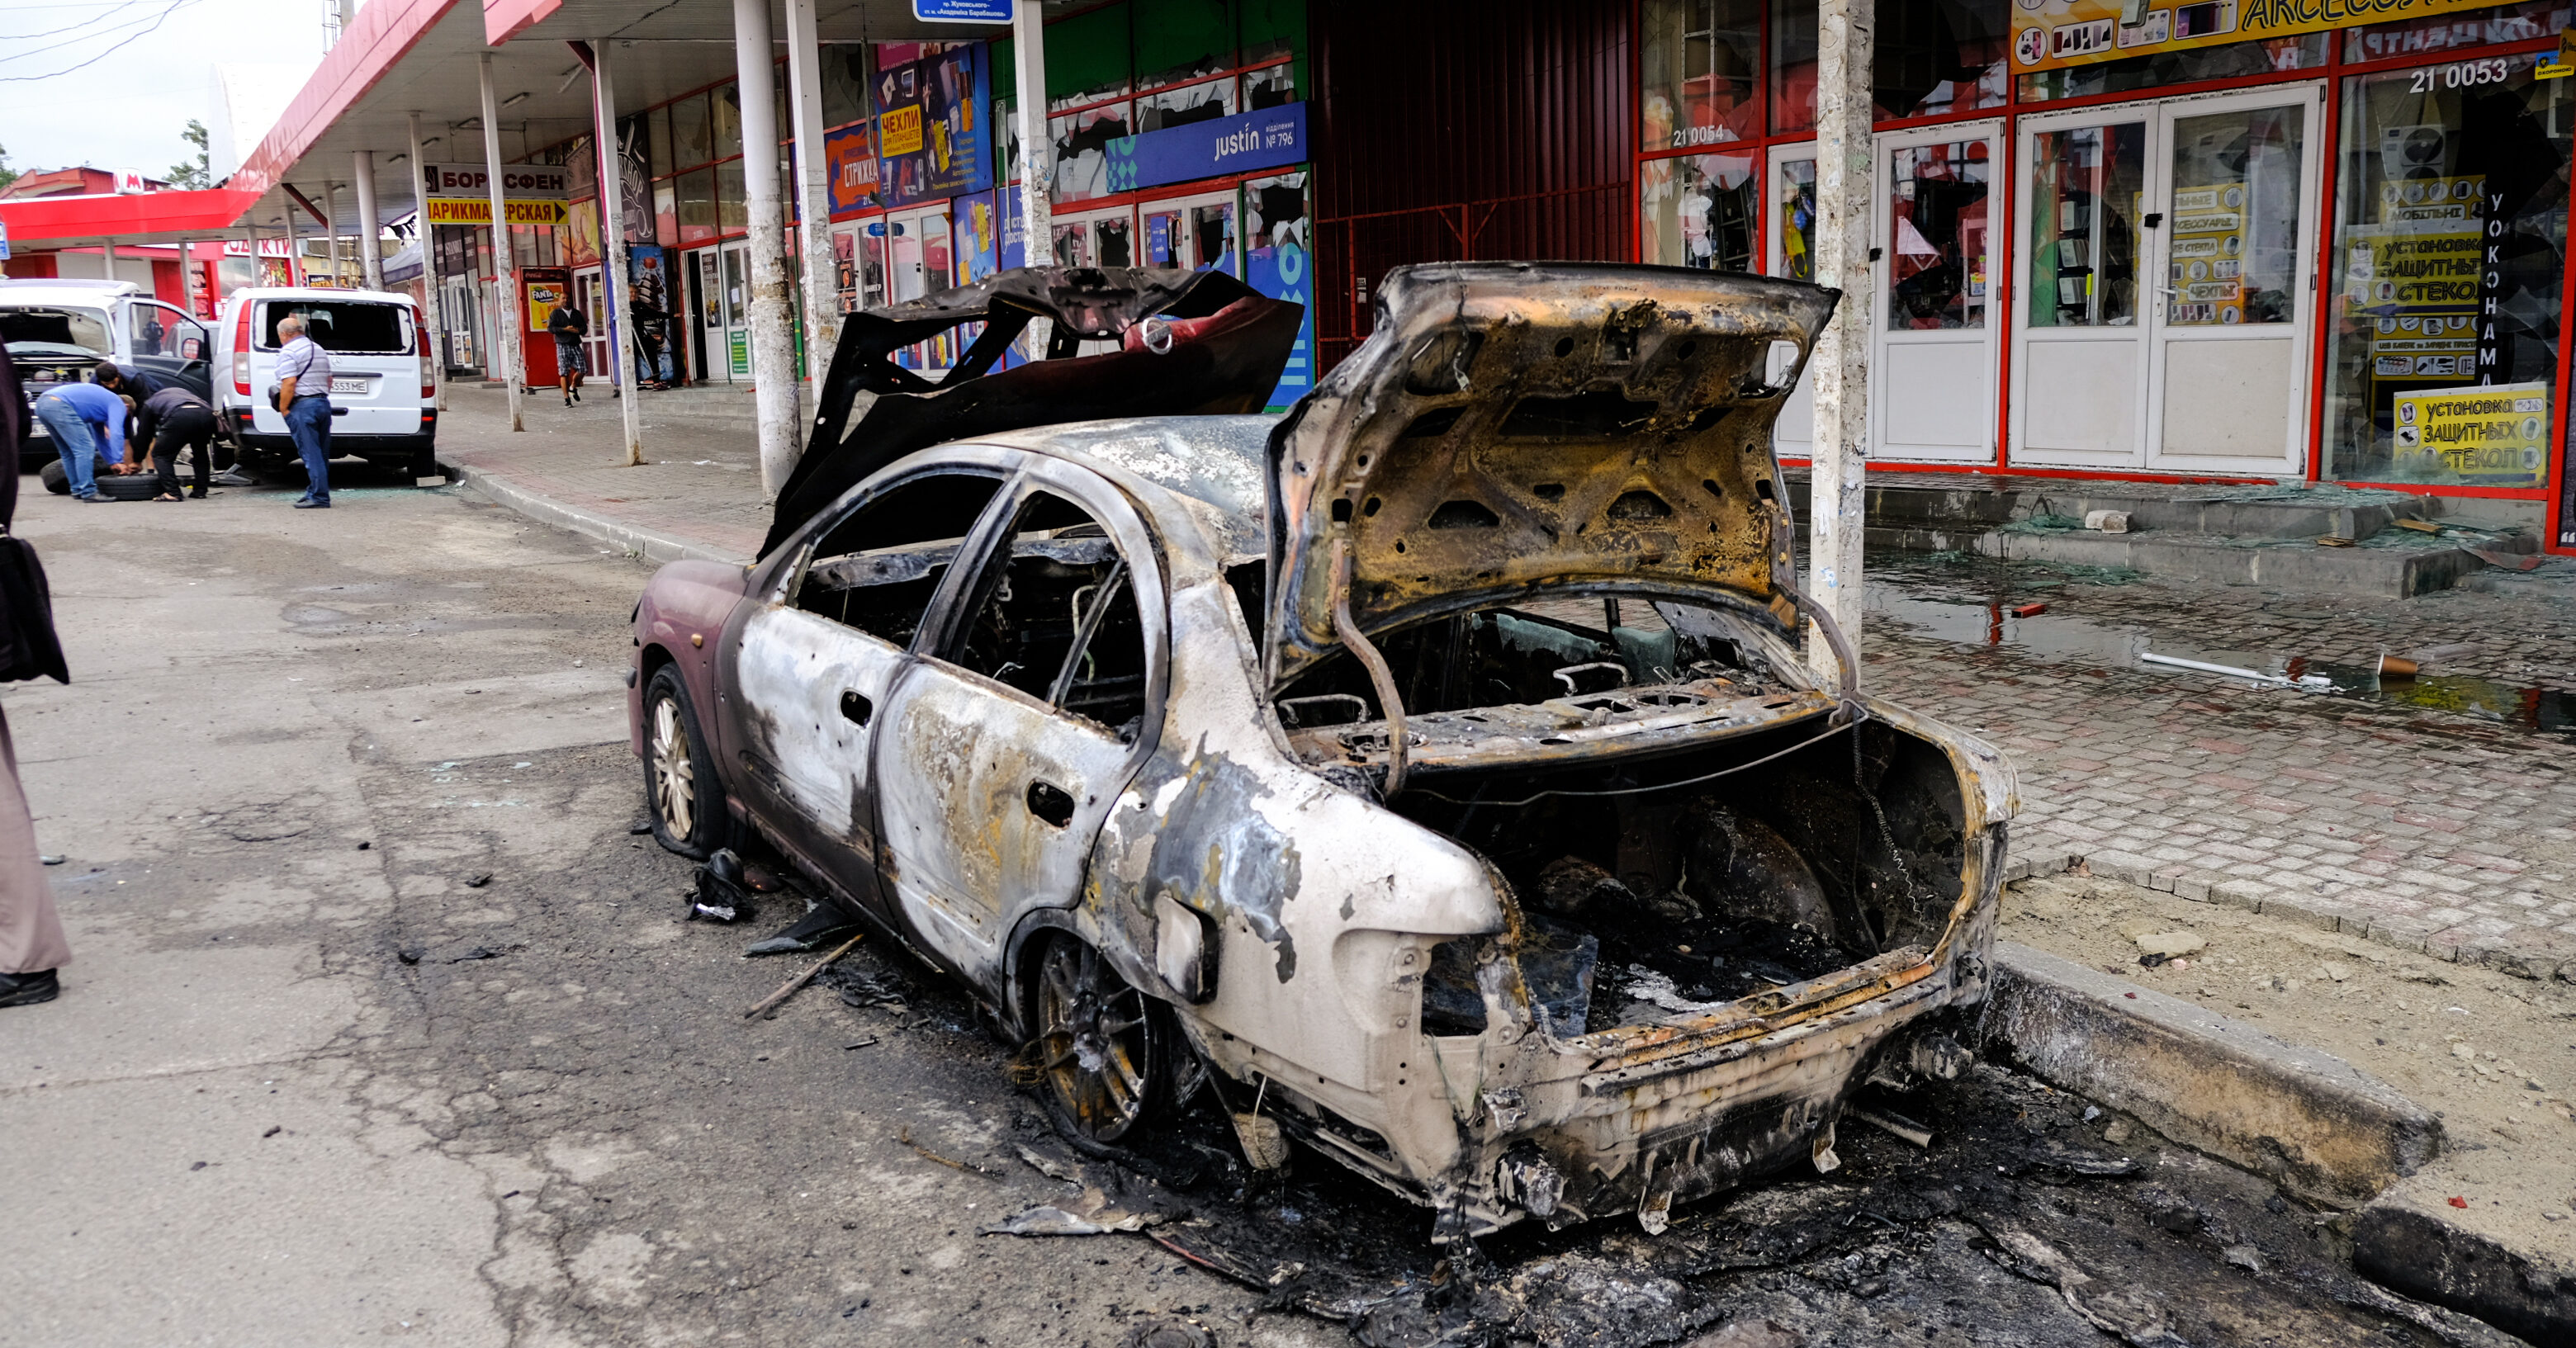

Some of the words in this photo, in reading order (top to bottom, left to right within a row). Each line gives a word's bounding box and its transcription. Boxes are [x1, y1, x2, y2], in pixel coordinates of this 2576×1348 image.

[2409, 68, 2435, 93] 21
[2446, 59, 2507, 88] 0053
[2537, 67, 2572, 76] ОХОРОНОЮ
[882, 109, 919, 135] ЧЕХЛИ
[1266, 121, 1295, 133] відділення
[1278, 132, 1293, 147] 796
[1673, 129, 1686, 146] 21
[1691, 124, 1724, 144] 0054
[443, 172, 564, 190] БОРСФЕН
[618, 154, 644, 199] RSHOP
[844, 158, 879, 188] СТРИЖКА
[2380, 258, 2480, 279] ЗАЩИТНЫ
[2190, 286, 2236, 299] ЧЕХЛЫ
[2397, 281, 2480, 302] СТЕКО
[331, 382, 349, 390] 553
[2424, 421, 2518, 444] ЗАЩИТНЫХ
[2440, 447, 2517, 470] СТЕКОЛ
